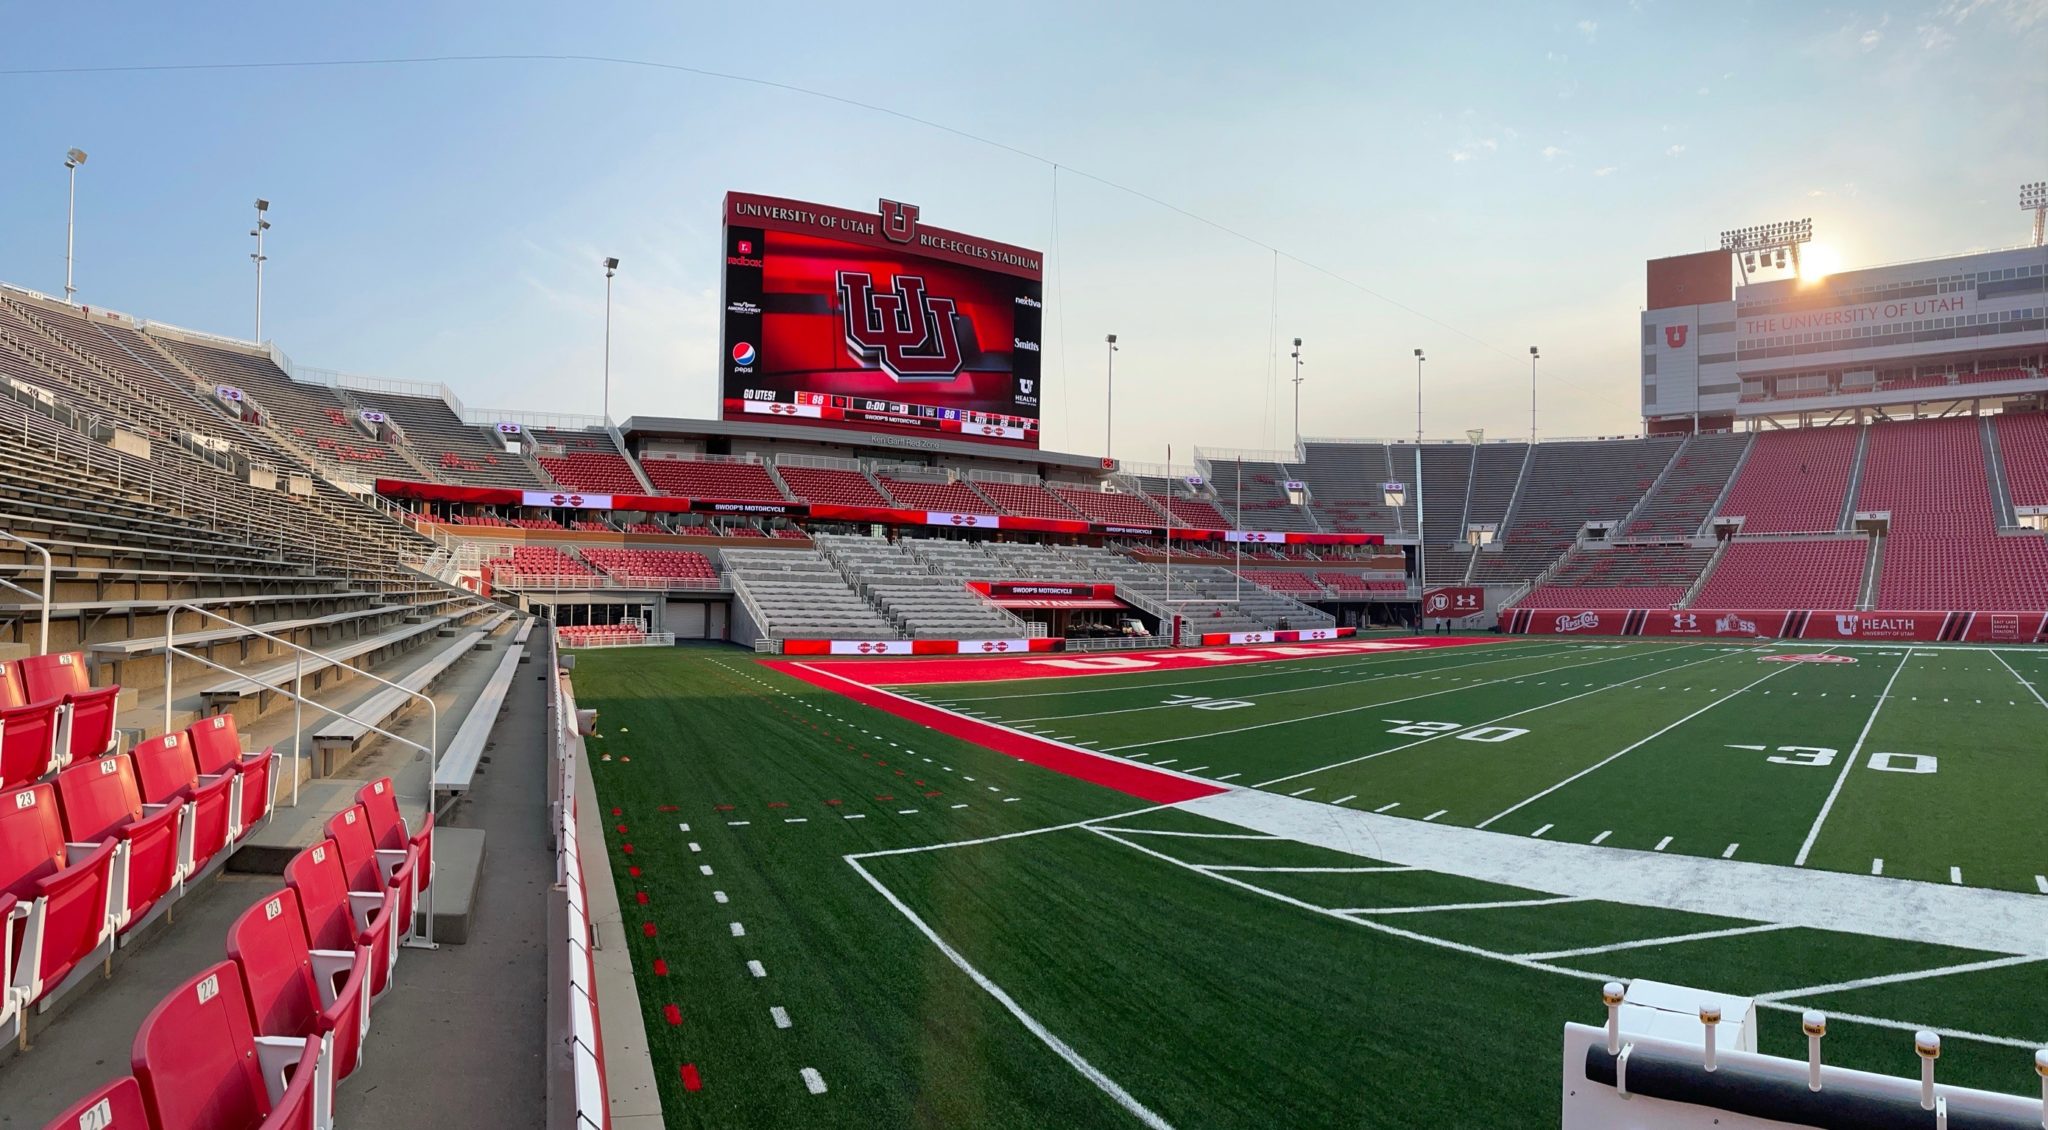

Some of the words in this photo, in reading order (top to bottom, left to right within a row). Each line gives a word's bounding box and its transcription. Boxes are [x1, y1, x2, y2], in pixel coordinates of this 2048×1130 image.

[736, 202, 817, 224] UNIVERSITY
[820, 215, 837, 228] OF
[841, 218, 875, 235] UTAH
[879, 198, 919, 243] U
[920, 234, 988, 259] RICE-ECCLES
[990, 249, 1039, 271] STADIUM
[1015, 296, 1041, 308] nextiva
[1746, 319, 1776, 334] THE
[1782, 306, 1878, 330] UNIVERSITY
[1884, 303, 1908, 319] OF
[1914, 296, 1964, 315] UTAH
[1665, 325, 1688, 348] U
[1014, 338, 1039, 351] Smith's
[734, 366, 753, 374] pepsi
[743, 389, 754, 399] GO
[755, 390, 776, 401] UTES!
[812, 395, 824, 405] 88
[1015, 394, 1037, 404] HEALTH
[865, 401, 885, 411] 0:00
[864, 414, 888, 422] SWOOP'S
[889, 416, 921, 425] MOTORCYCLE
[944, 410, 955, 419] 88
[205, 439, 215, 448] 41
[715, 503, 743, 511] SWOOP'S
[744, 505, 786, 513] MOTORCYCLE
[1038, 587, 1073, 595] MOTORCYCLE
[1862, 618, 1914, 630] HEALTH
[1385, 721, 1531, 742] 20
[166, 737, 175, 746] 25
[1766, 746, 1938, 773] 30
[103, 760, 114, 772] 24
[19, 792, 32, 806] 23
[315, 848, 323, 861] 24
[268, 902, 279, 917] 23
[201, 978, 215, 999] 22
[86, 1103, 106, 1130] 21
